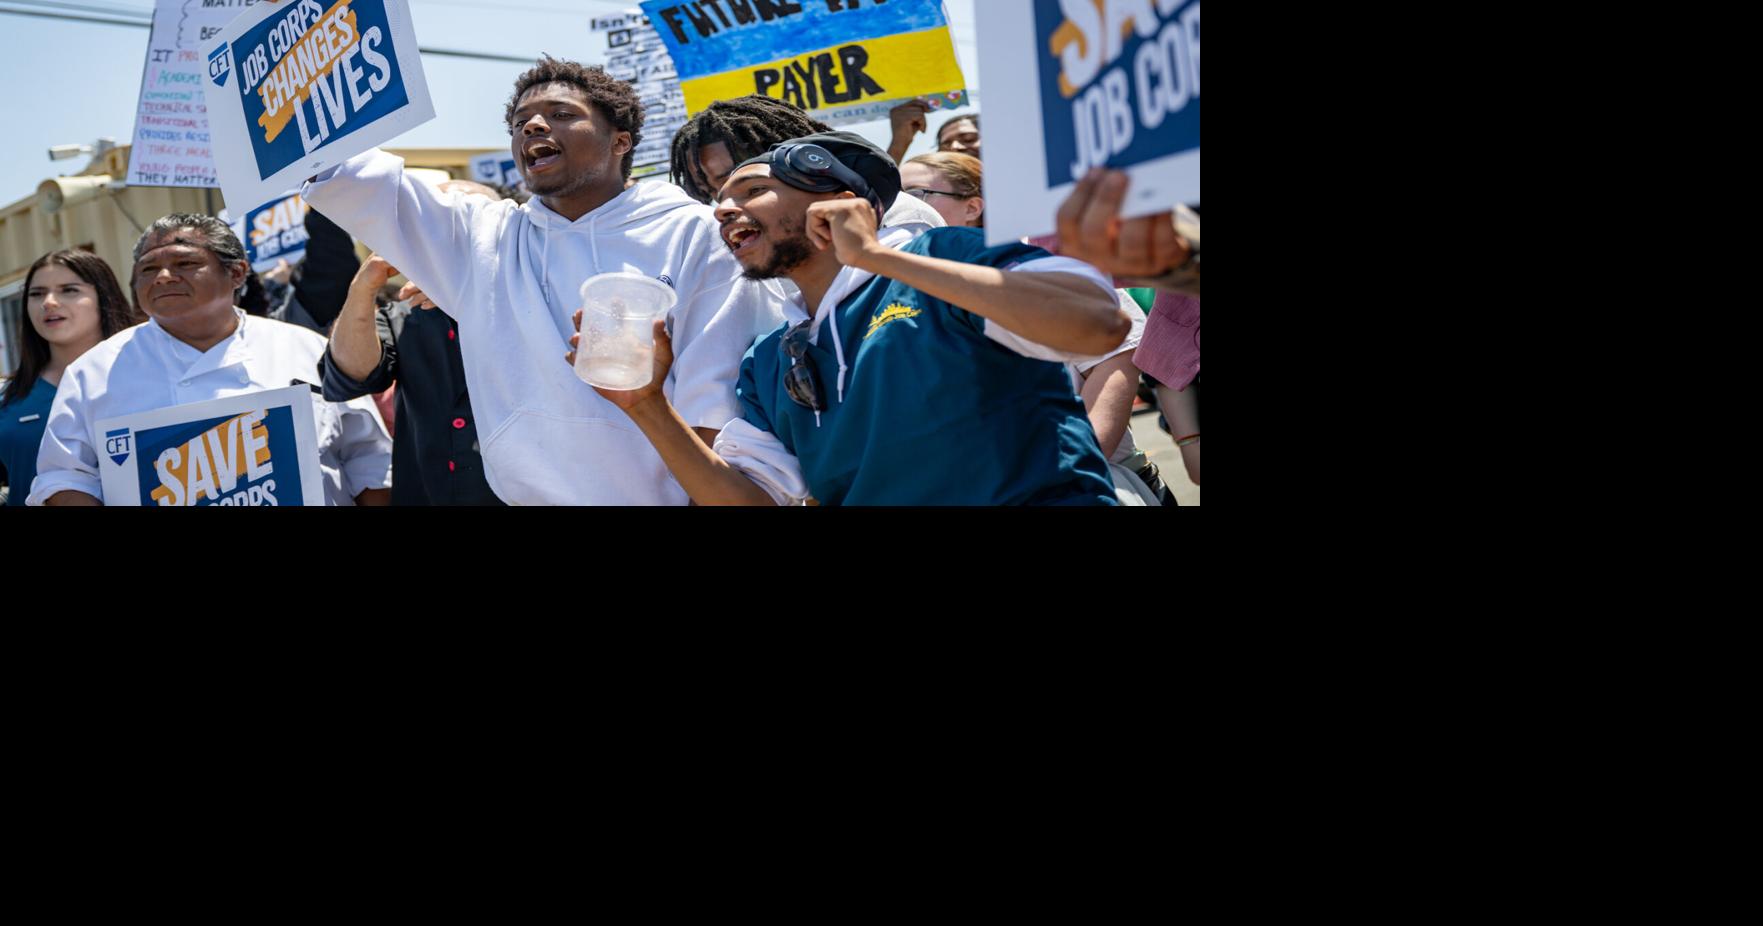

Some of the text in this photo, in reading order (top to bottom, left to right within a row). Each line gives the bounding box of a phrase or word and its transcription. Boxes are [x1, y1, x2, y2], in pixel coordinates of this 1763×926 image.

[151, 49, 173, 63] IT
[208, 49, 231, 79] CFT
[242, 0, 323, 95] JOB CORPS
[262, 4, 354, 117] CHANGES
[753, 44, 886, 110] PAYER
[293, 25, 391, 155] LIVES
[1070, 66, 1135, 179] JOB
[135, 171, 168, 184] THEY
[106, 436, 131, 455] CFT
[157, 409, 273, 506] SAVE
